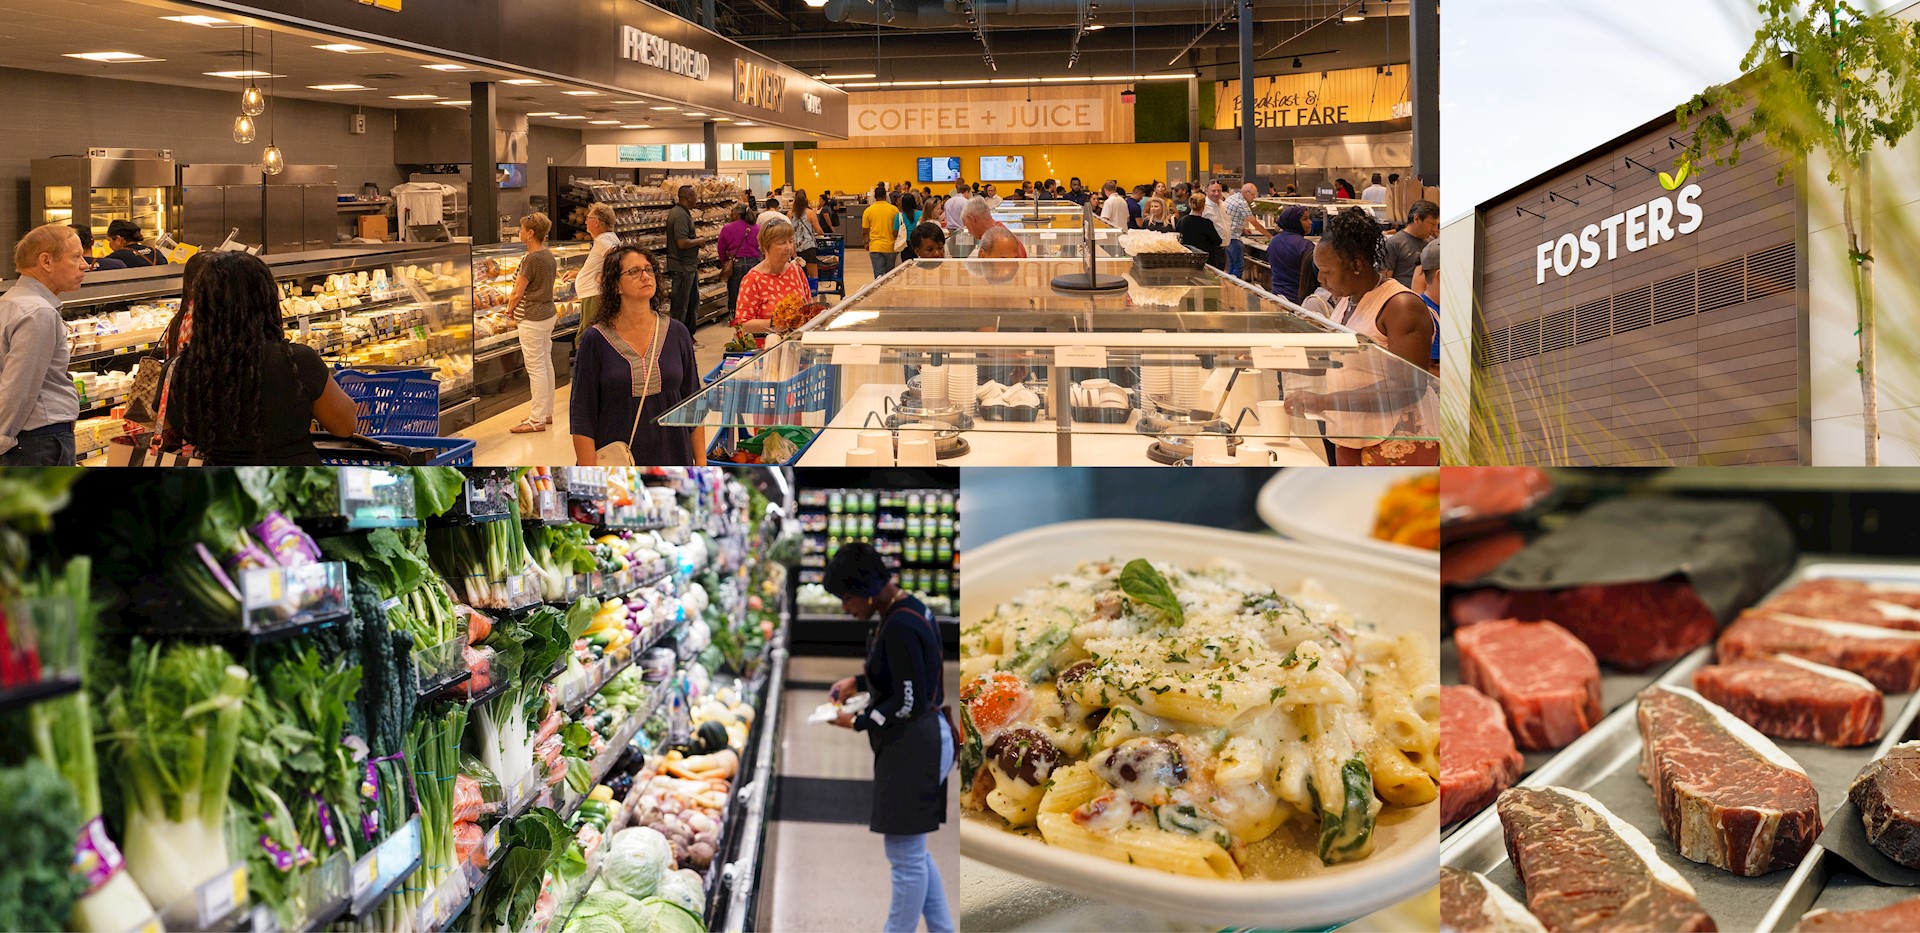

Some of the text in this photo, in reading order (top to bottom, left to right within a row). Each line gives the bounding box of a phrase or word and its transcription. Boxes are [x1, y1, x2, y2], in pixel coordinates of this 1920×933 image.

[621, 25, 710, 81] FRESH BREAD
[733, 57, 786, 114] BAKERY
[1233, 90, 1318, 111] Beakfast &
[857, 106, 970, 131] COFFEE
[1006, 104, 1091, 128] JUICE
[1233, 105, 1349, 129] LGHT FARE
[1536, 183, 1704, 285] FOSTERS
